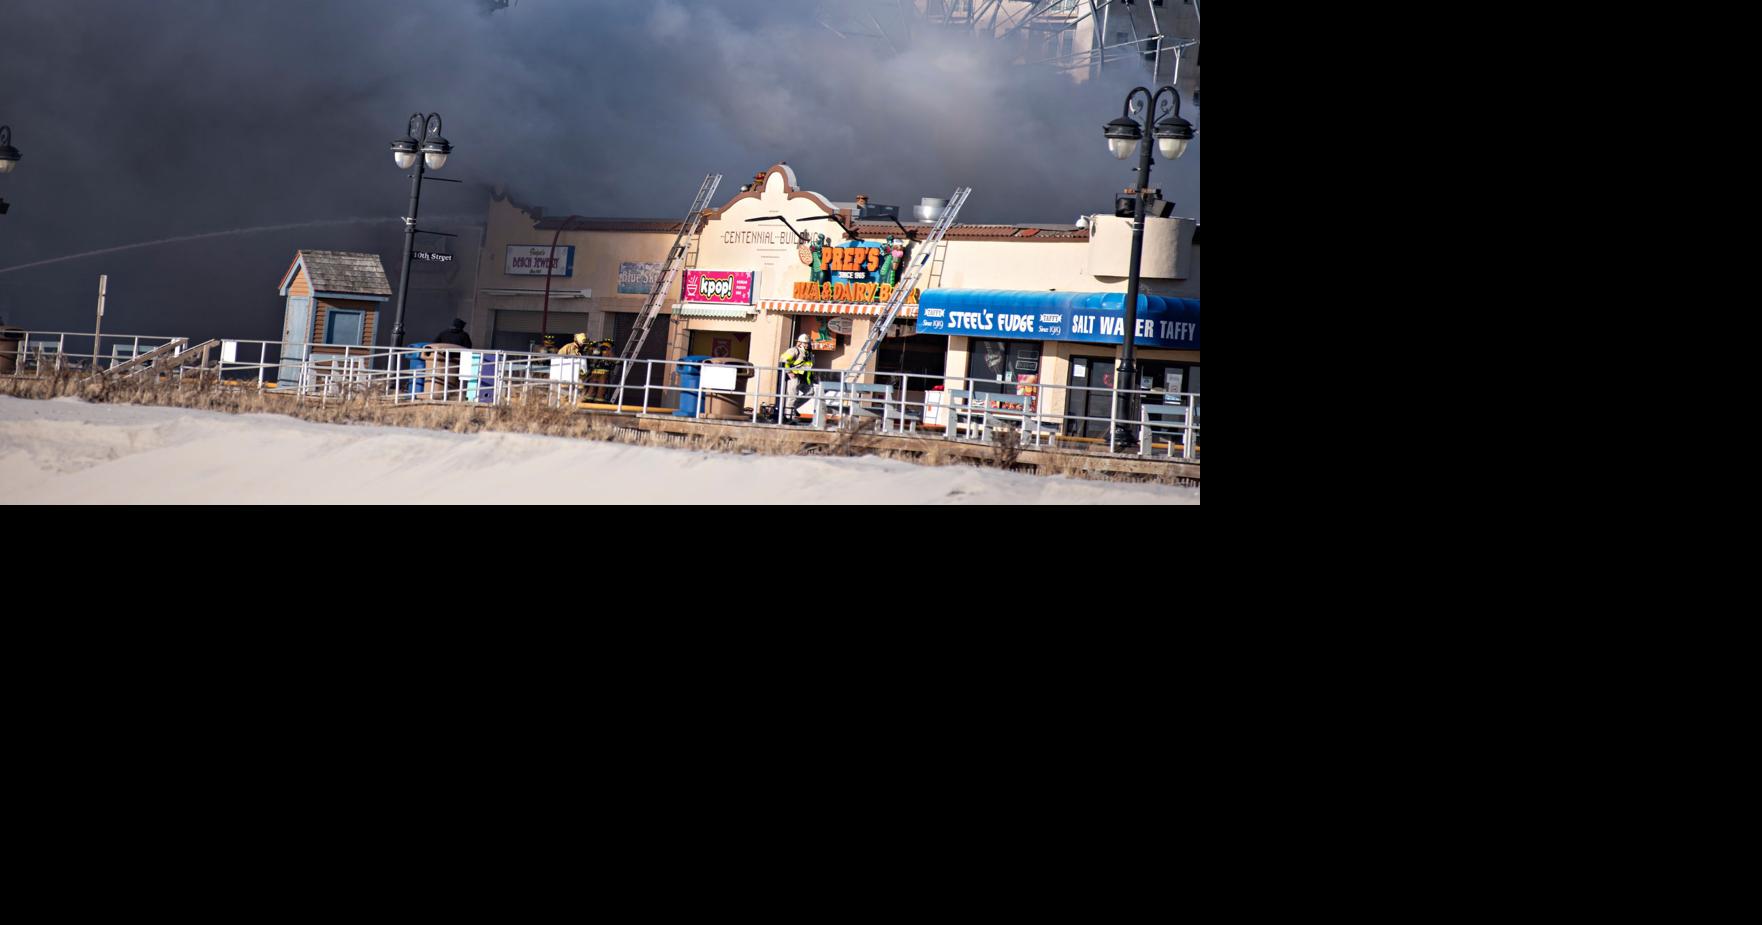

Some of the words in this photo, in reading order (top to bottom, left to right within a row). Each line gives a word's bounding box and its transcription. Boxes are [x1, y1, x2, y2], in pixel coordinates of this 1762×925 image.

[723, 231, 775, 244] CENTENNIAL
[414, 252, 430, 260] 10th
[820, 246, 881, 272] PREP'S
[700, 275, 734, 299] kpop!
[822, 281, 832, 301] &
[833, 281, 879, 302] DAIRY
[947, 308, 994, 331] STEEL'S
[997, 313, 1035, 333] FUDGE
[1072, 314, 1096, 334] SALT
[1099, 316, 1155, 338] WAER
[1159, 320, 1196, 342] TAFFY
